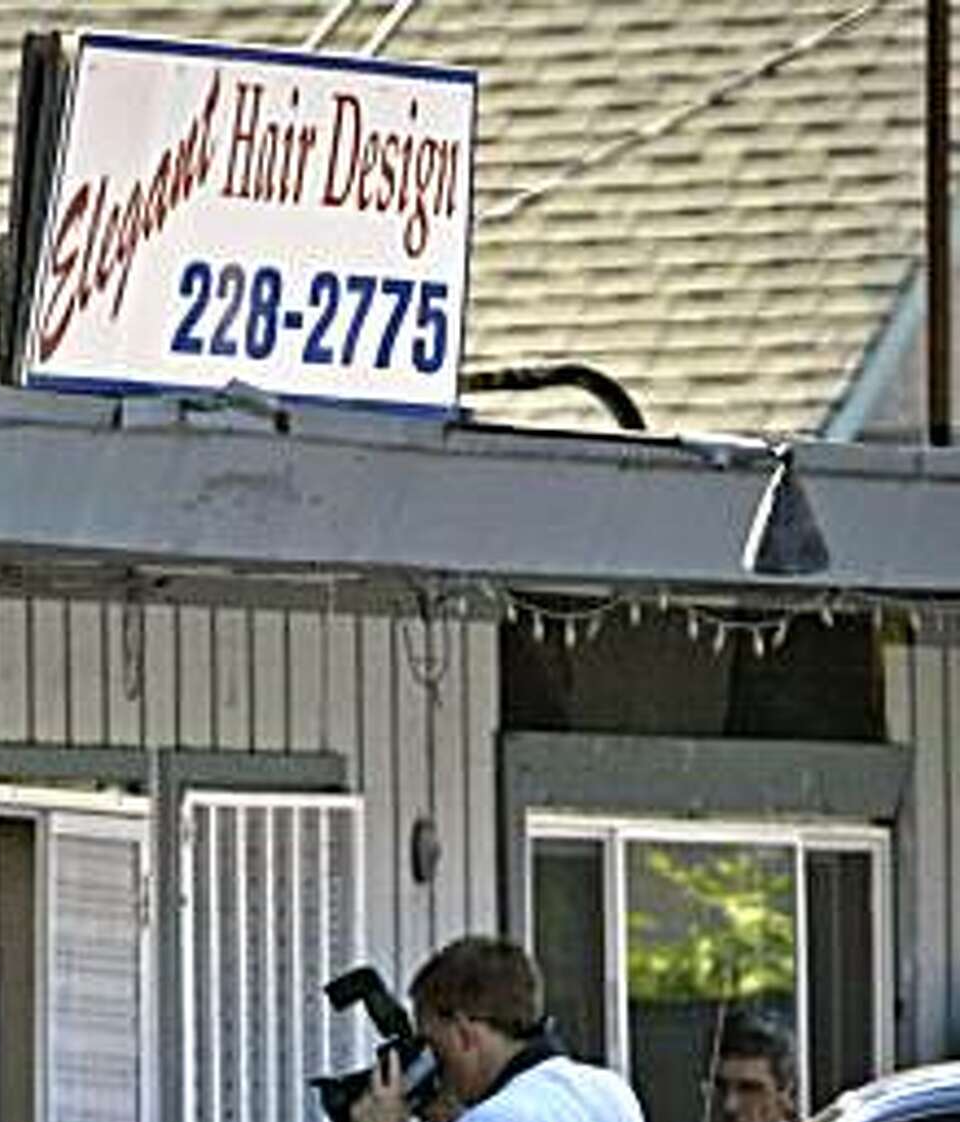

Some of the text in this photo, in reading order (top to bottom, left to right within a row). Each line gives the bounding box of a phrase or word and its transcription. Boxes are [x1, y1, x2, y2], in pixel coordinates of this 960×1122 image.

[222, 81, 317, 204] Hair
[322, 92, 462, 260] Design
[169, 260, 451, 375] 228-2775
